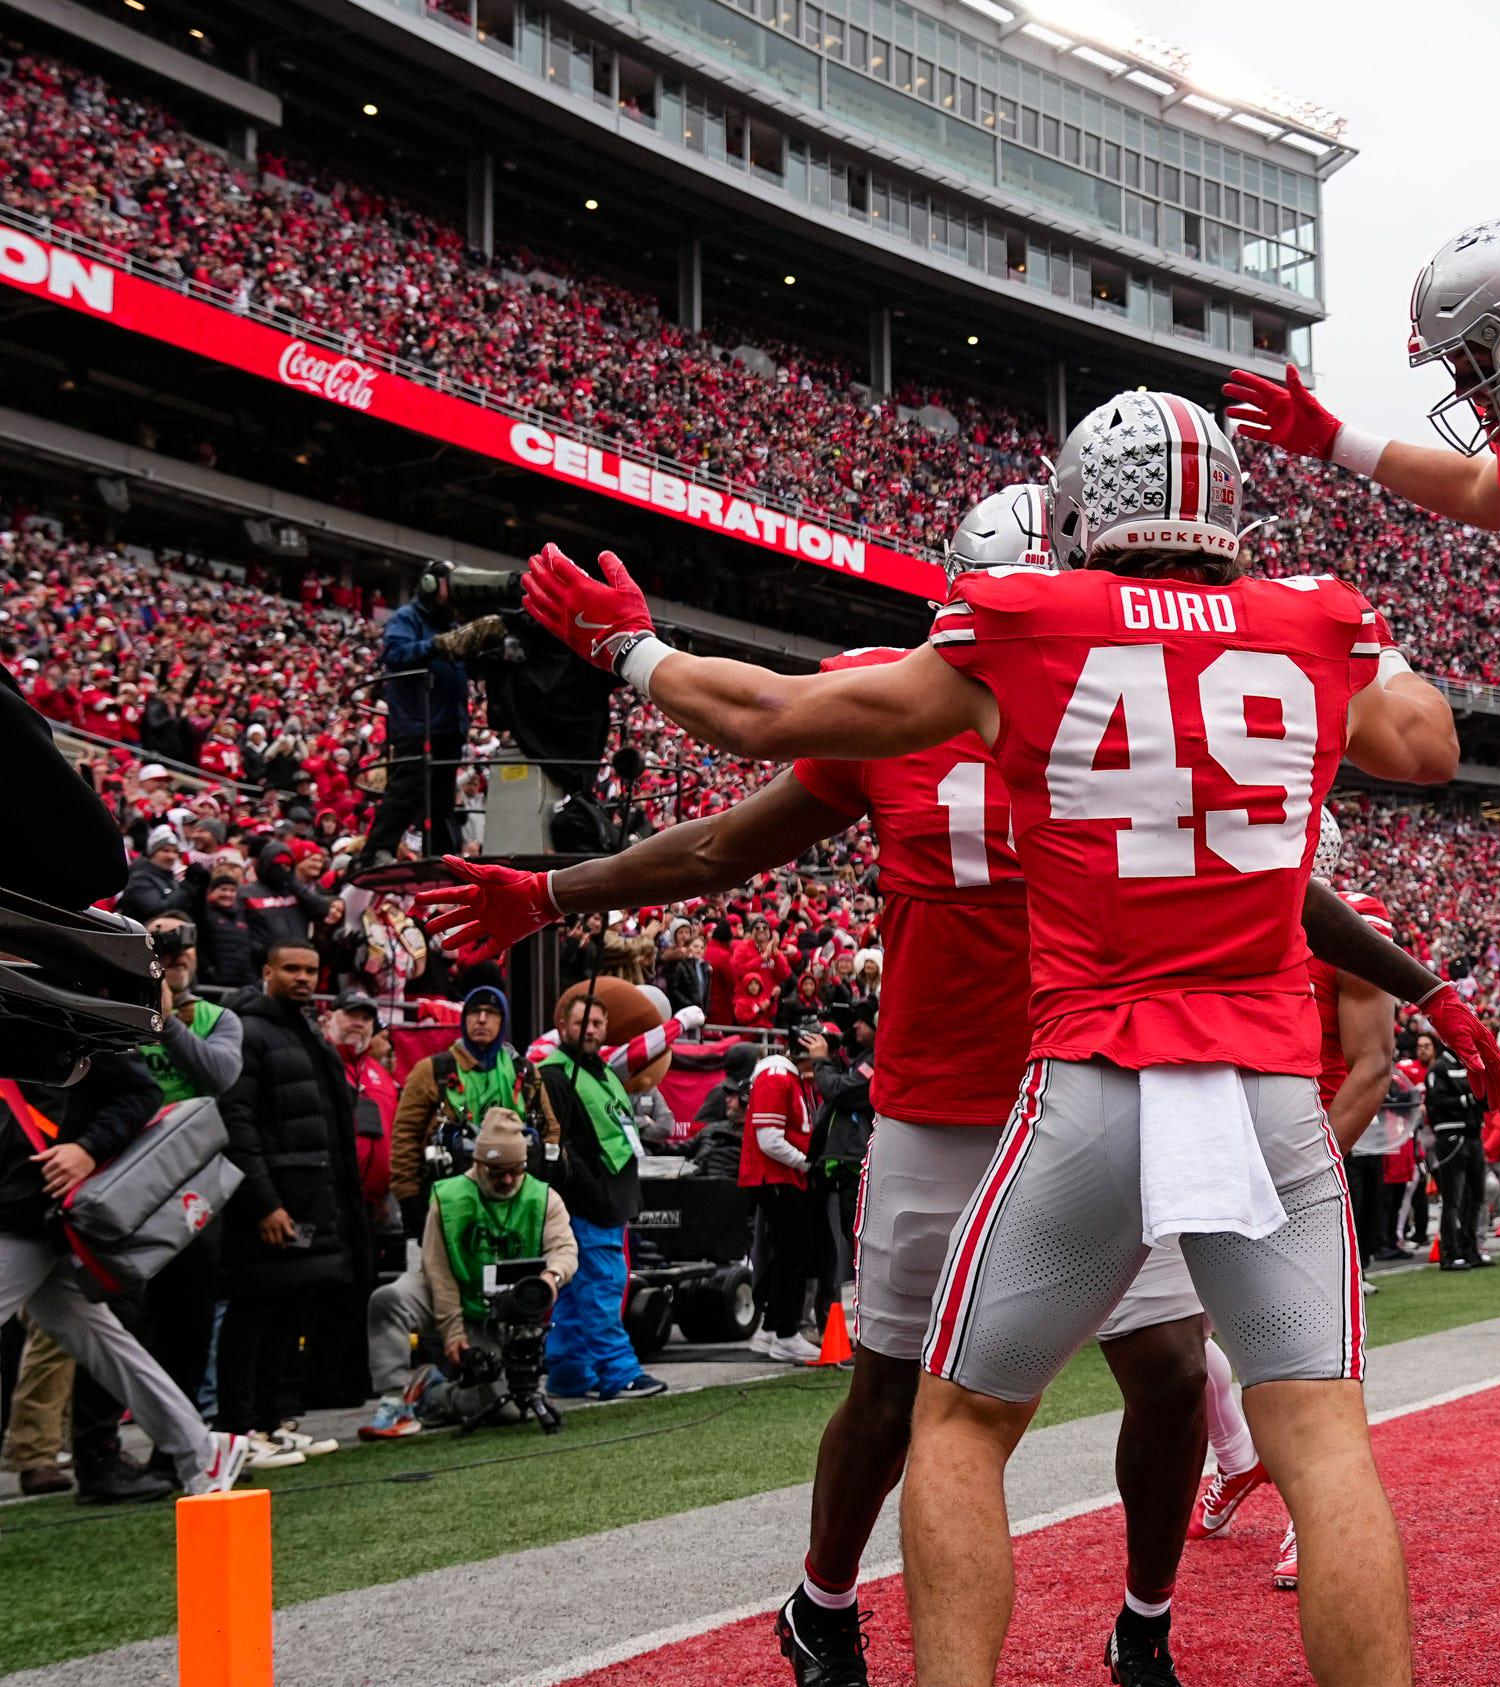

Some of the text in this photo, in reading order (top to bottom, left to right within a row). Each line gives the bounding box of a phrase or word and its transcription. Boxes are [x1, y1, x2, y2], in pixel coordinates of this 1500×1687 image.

[0, 229, 114, 313] ON
[279, 341, 378, 410] Coca-Cola
[509, 423, 866, 573] CELEBRATION
[1025, 553, 1046, 566] OHIO
[1127, 531, 1236, 552] BUCKEYES
[1121, 586, 1237, 633] GURD
[1045, 643, 1318, 879] 49
[937, 762, 1015, 888] 1
[637, 1210, 680, 1224] PMAN
